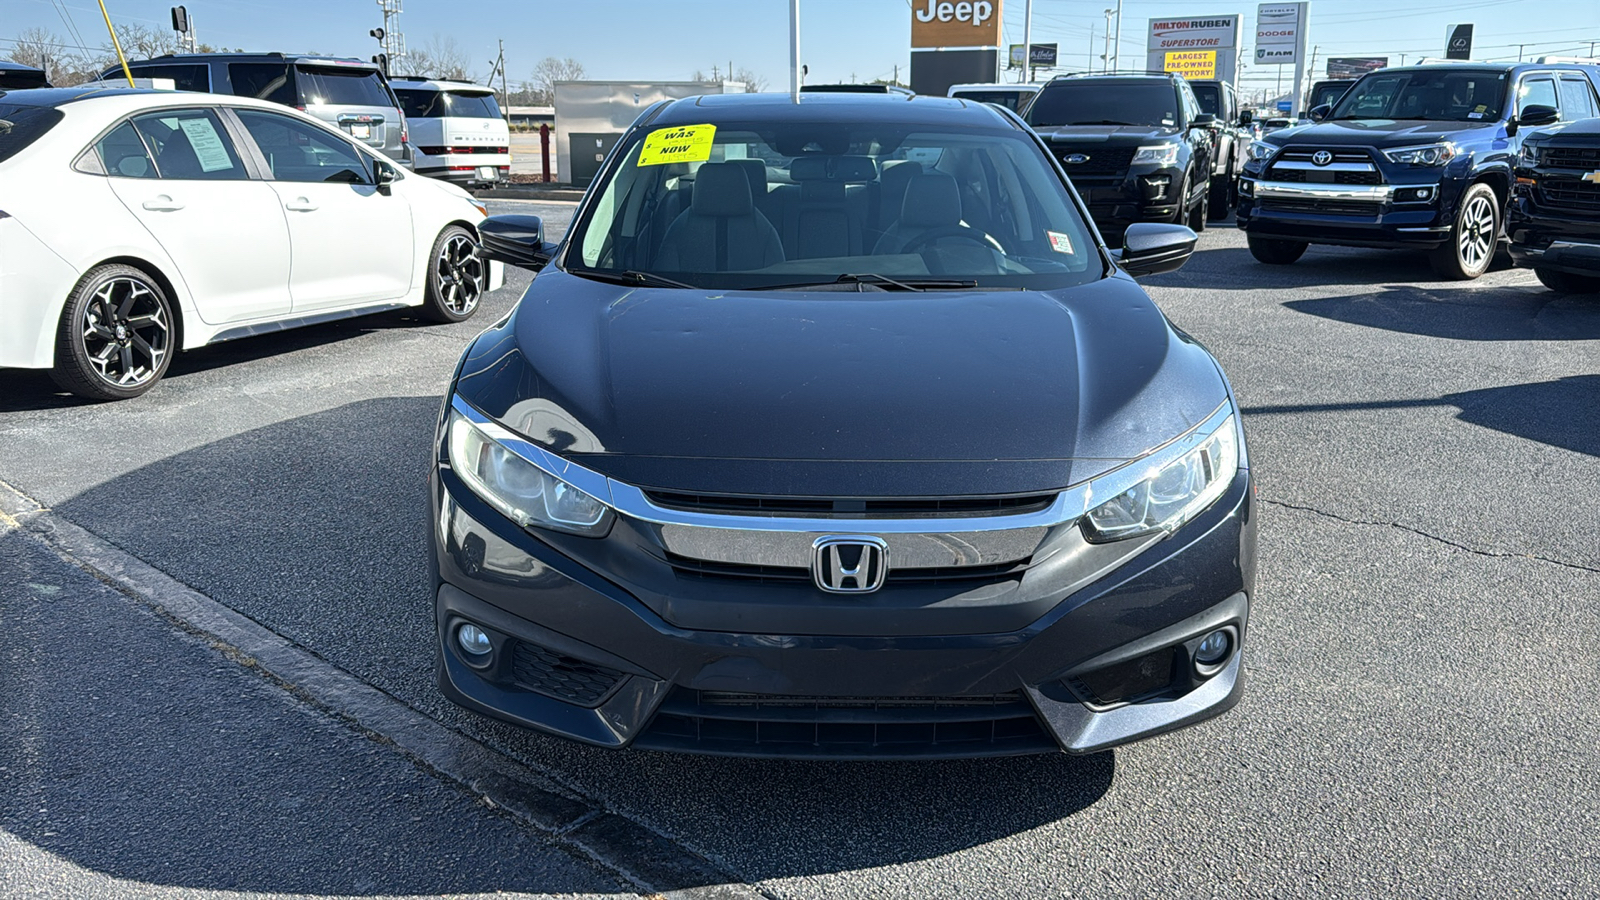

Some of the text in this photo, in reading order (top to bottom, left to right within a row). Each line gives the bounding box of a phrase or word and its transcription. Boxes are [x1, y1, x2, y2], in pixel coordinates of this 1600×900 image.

[916, 0, 993, 26] Jeep
[1153, 19, 1231, 30] MILTON RUBEN
[1160, 38, 1220, 47] SUPERSTORE
[664, 130, 695, 139] WAS
[660, 144, 691, 154] NOW
